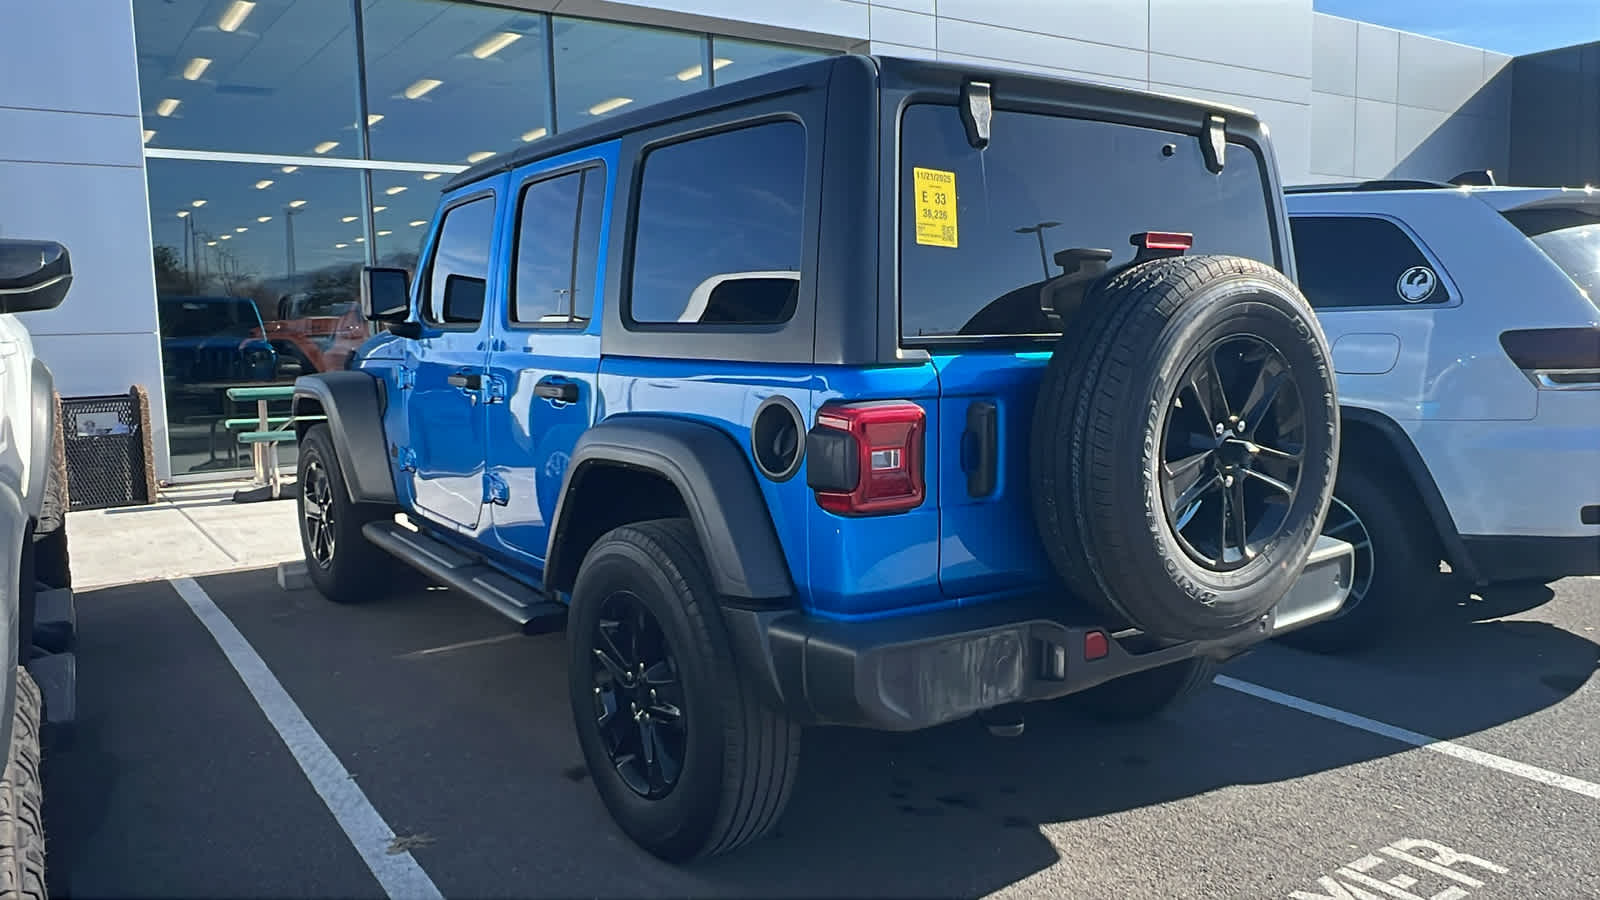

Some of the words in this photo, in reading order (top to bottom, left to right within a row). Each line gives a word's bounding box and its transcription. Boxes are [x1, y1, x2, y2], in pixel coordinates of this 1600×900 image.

[916, 171, 952, 184] 11/21/2025
[922, 191, 929, 203] E
[934, 192, 946, 205] 33
